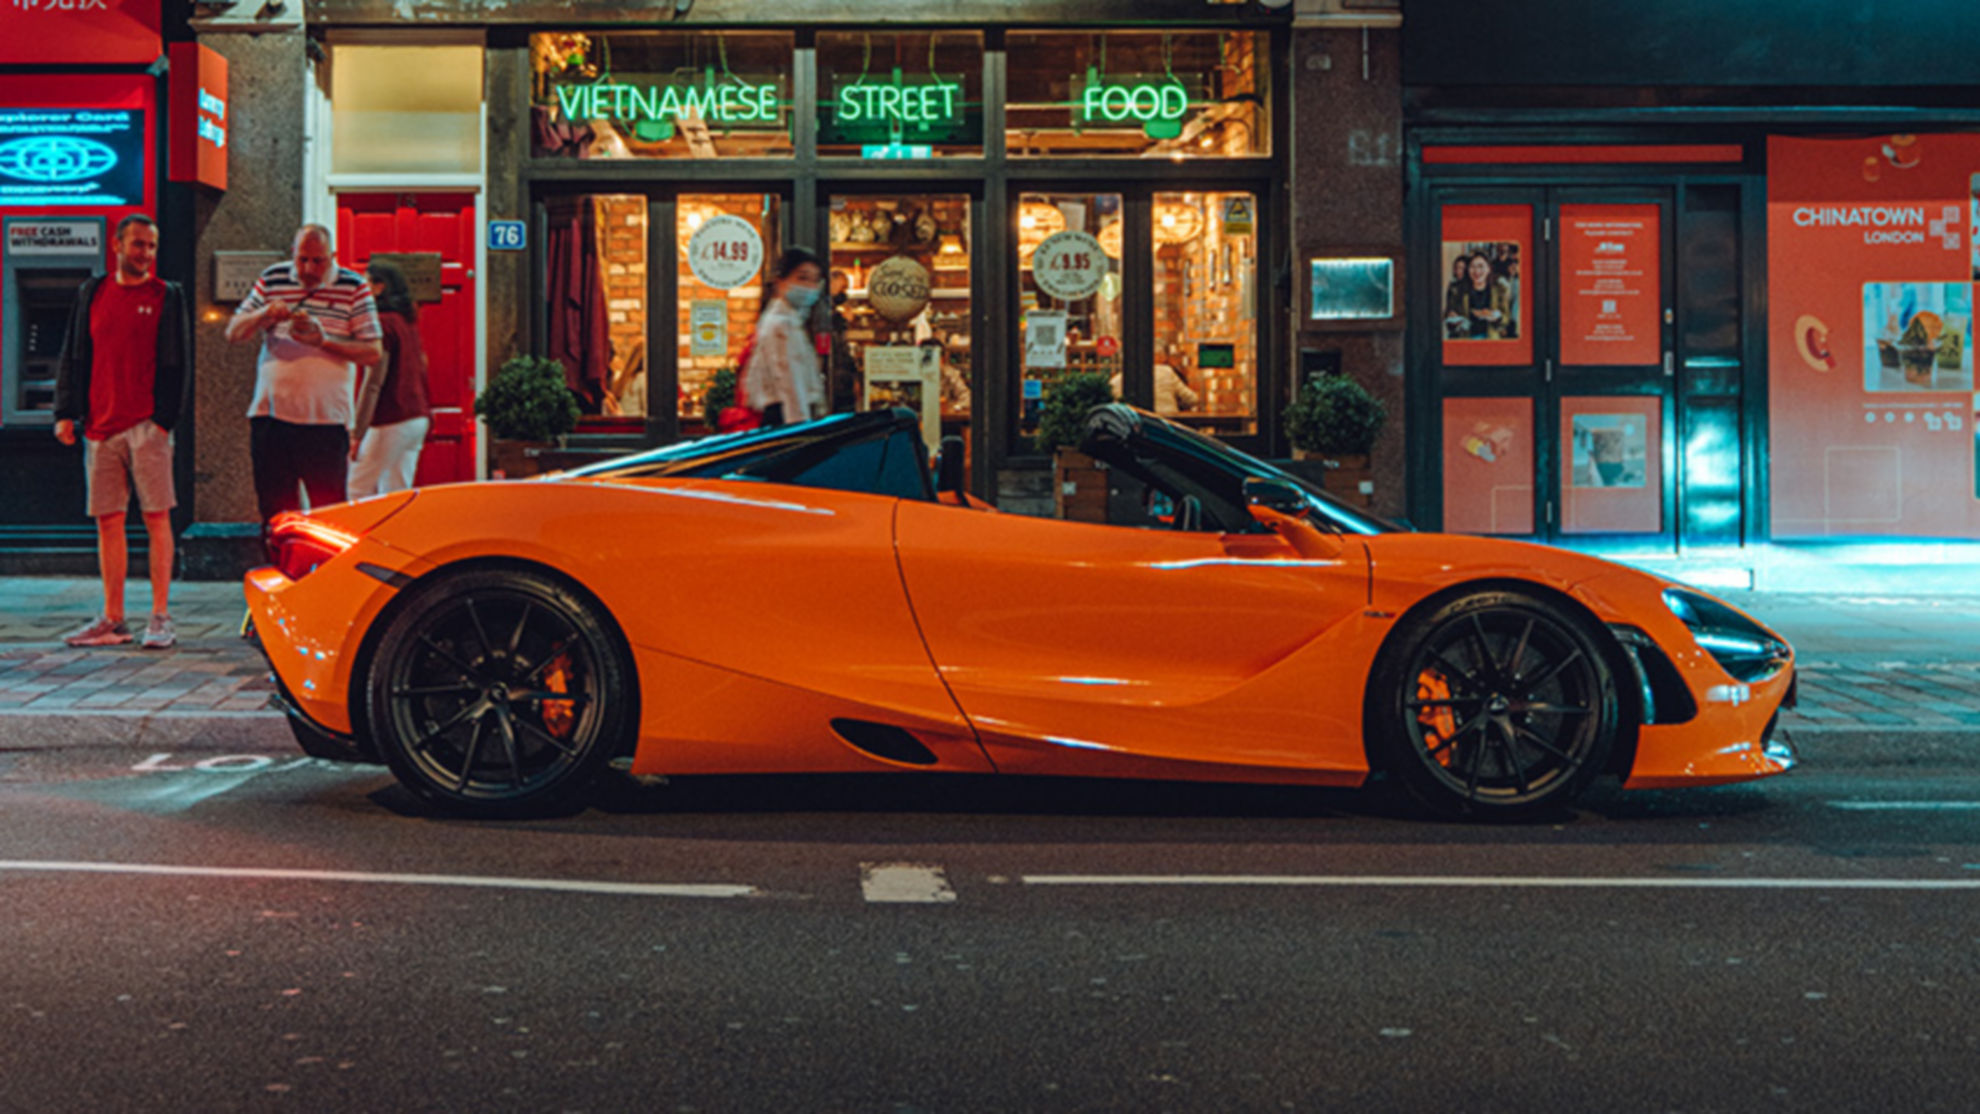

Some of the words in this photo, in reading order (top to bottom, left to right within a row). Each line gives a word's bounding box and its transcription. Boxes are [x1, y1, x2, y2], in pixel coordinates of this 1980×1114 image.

[556, 84, 778, 121] VIETNAMESE
[838, 84, 960, 121] STREET
[1083, 85, 1188, 121] FOOD
[1793, 207, 1924, 226] CHINATOWN
[10, 227, 38, 236] FREE
[41, 227, 71, 236] CASH
[493, 225, 519, 245] 76
[1864, 231, 1924, 244] LONDON
[11, 237, 97, 247] WITHDRAWALS
[701, 241, 748, 261] £14.99
[1049, 252, 1091, 270] £9.95
